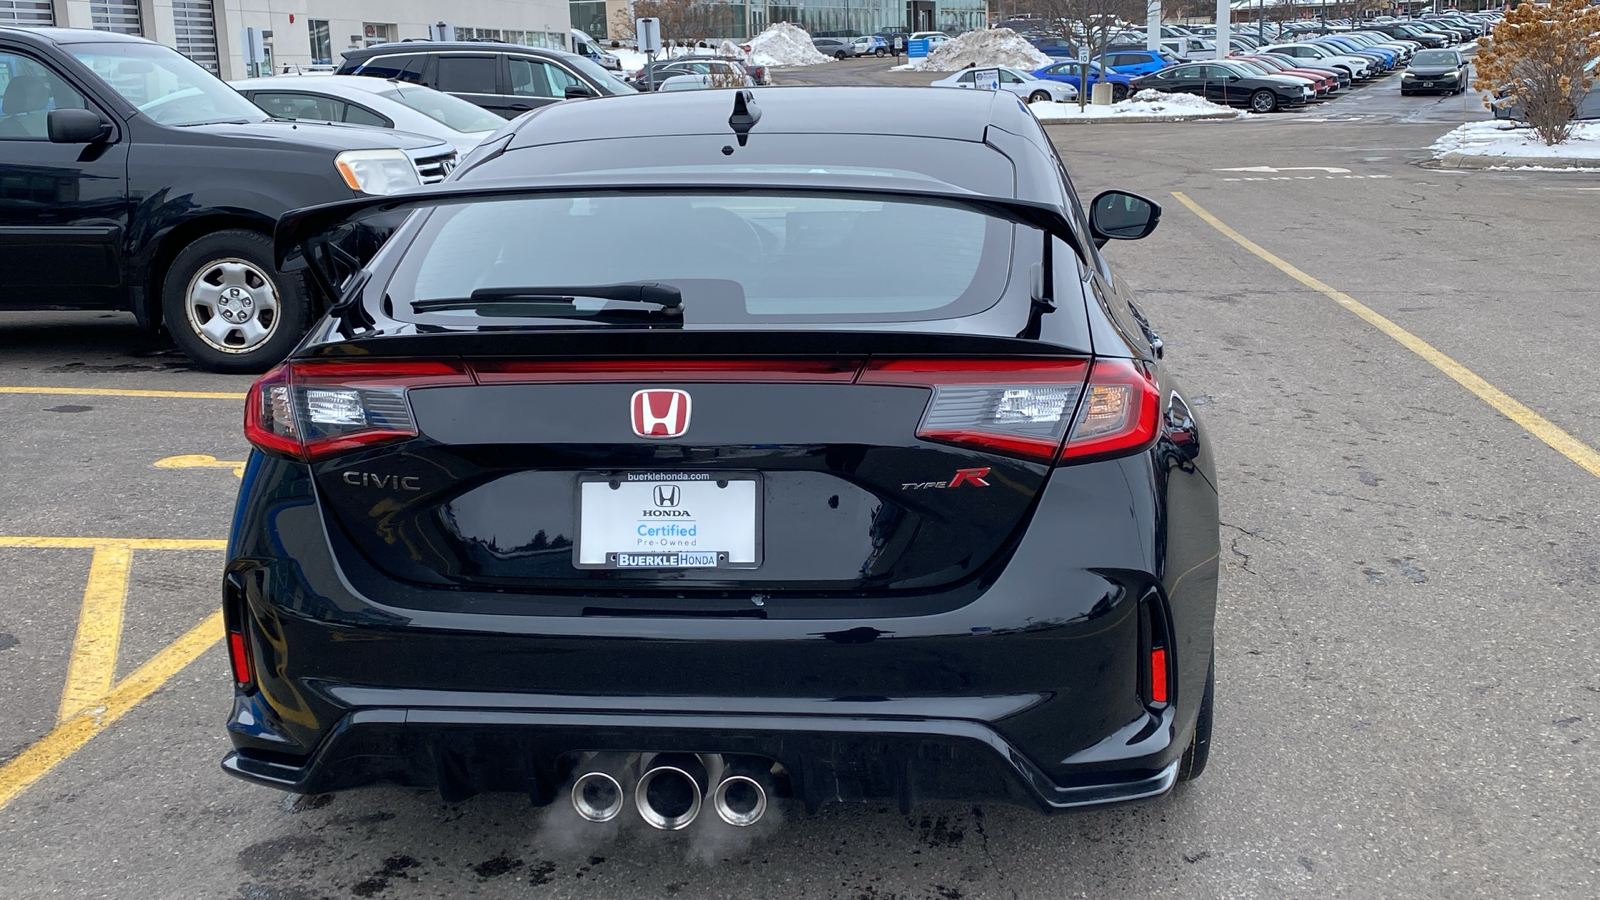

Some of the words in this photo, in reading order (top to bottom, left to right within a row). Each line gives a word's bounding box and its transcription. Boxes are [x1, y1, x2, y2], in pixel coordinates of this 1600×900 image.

[343, 471, 421, 491] CIVIC
[627, 472, 710, 481] buerklehonda.com
[902, 481, 947, 490] TYPE
[947, 467, 991, 488] R
[642, 509, 691, 517] HONDA
[637, 524, 697, 537] Certified
[637, 538, 697, 547] Pre-Owned
